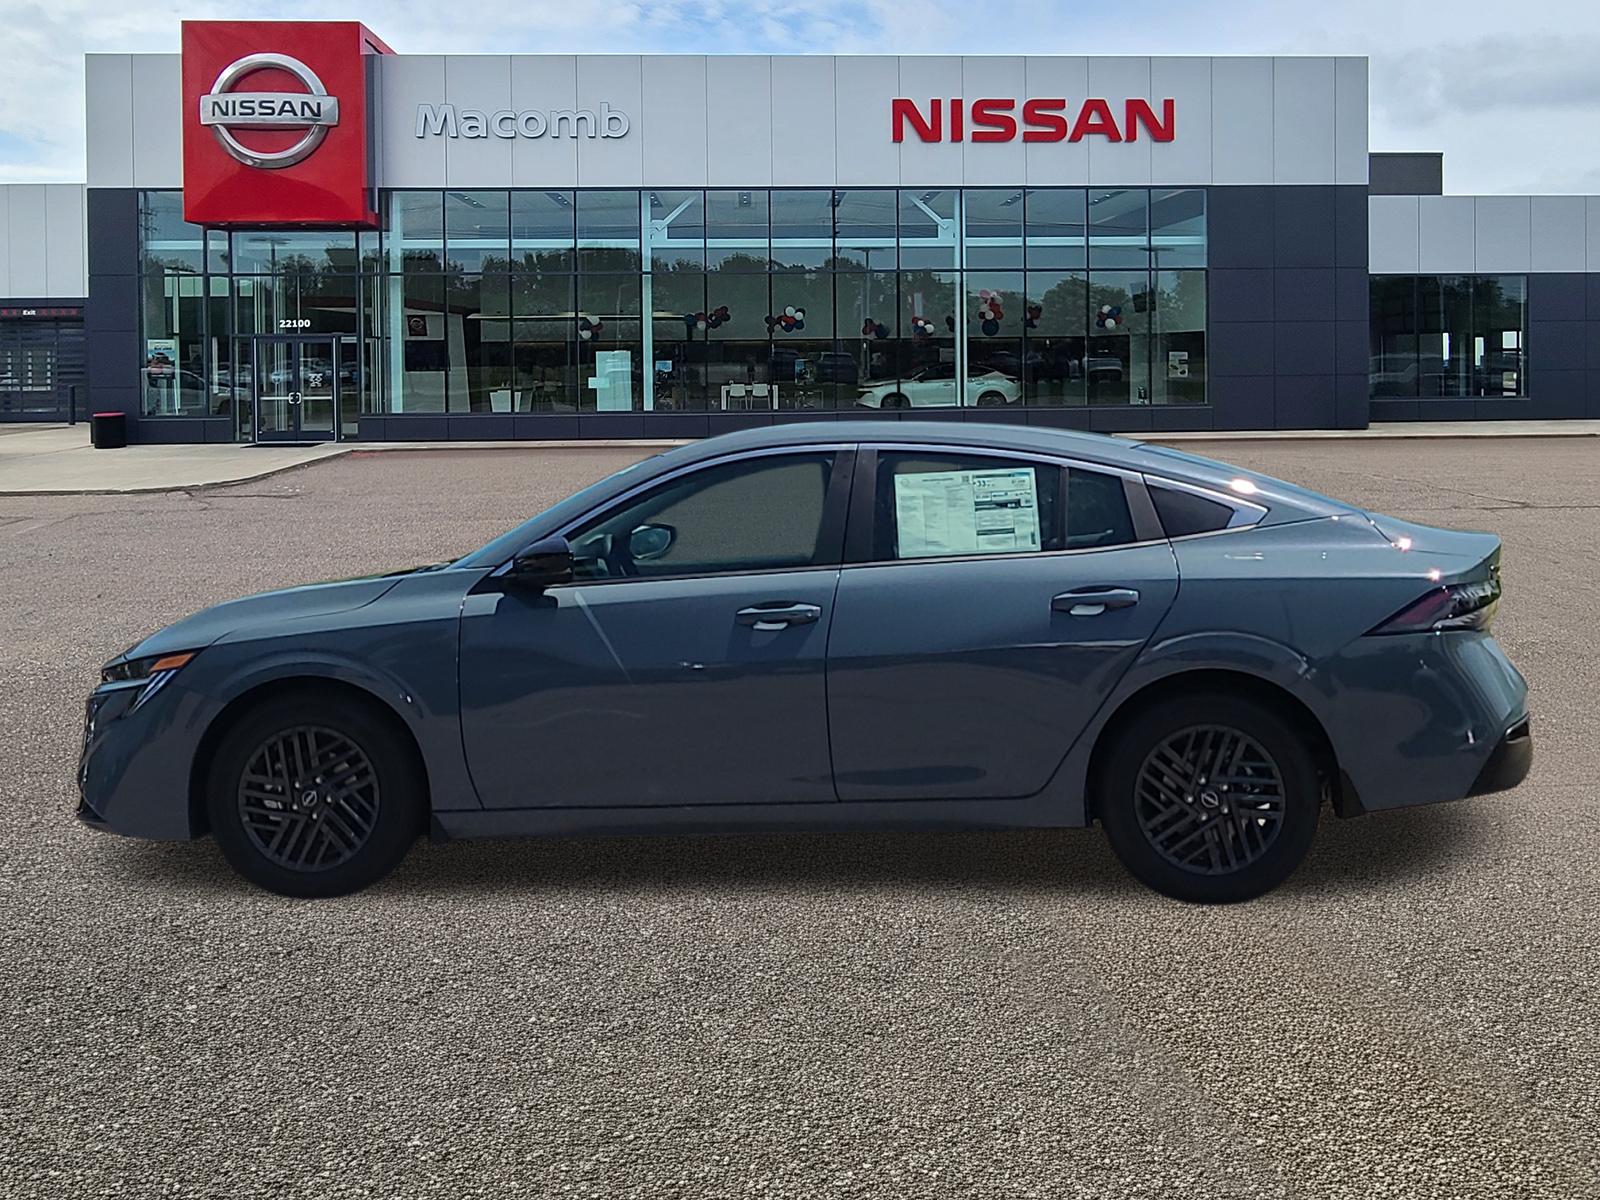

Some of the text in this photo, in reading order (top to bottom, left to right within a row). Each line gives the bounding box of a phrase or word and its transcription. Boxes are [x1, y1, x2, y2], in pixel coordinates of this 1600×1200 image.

[212, 100, 322, 118] NISSAN
[415, 102, 630, 139] Macomb
[892, 98, 1175, 143] NISSAN
[279, 319, 311, 328] 22100
